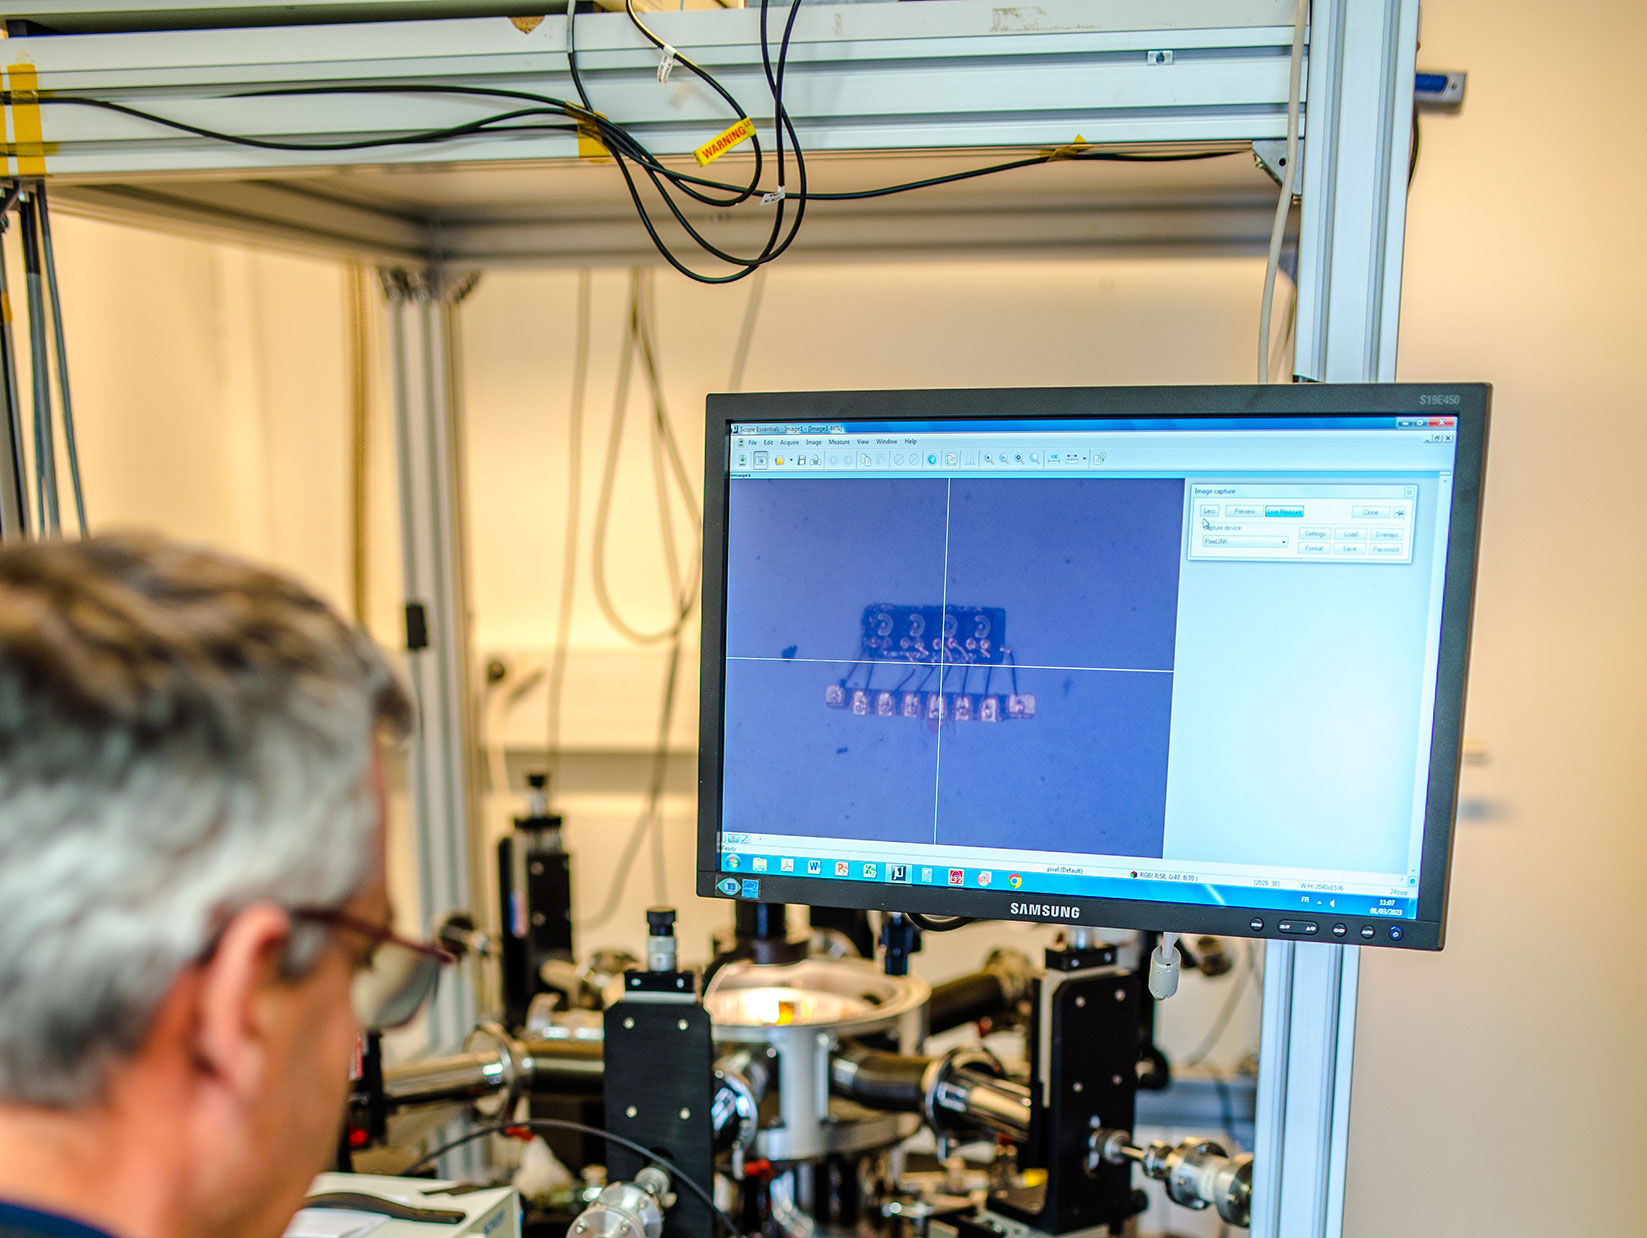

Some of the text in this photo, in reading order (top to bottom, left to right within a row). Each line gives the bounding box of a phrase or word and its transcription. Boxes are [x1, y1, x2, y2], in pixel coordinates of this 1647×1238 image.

[702, 126, 746, 159] WARNING
[1420, 394, 1460, 405] S19E450
[780, 439, 799, 447] Acquire
[806, 439, 822, 447] Image
[904, 438, 918, 446] Help
[1194, 488, 1236, 496] Image capture
[1379, 899, 1396, 907] 11:07
[1010, 902, 1080, 919] SAMSUNG
[1369, 907, 1403, 917] 01/03/2023
